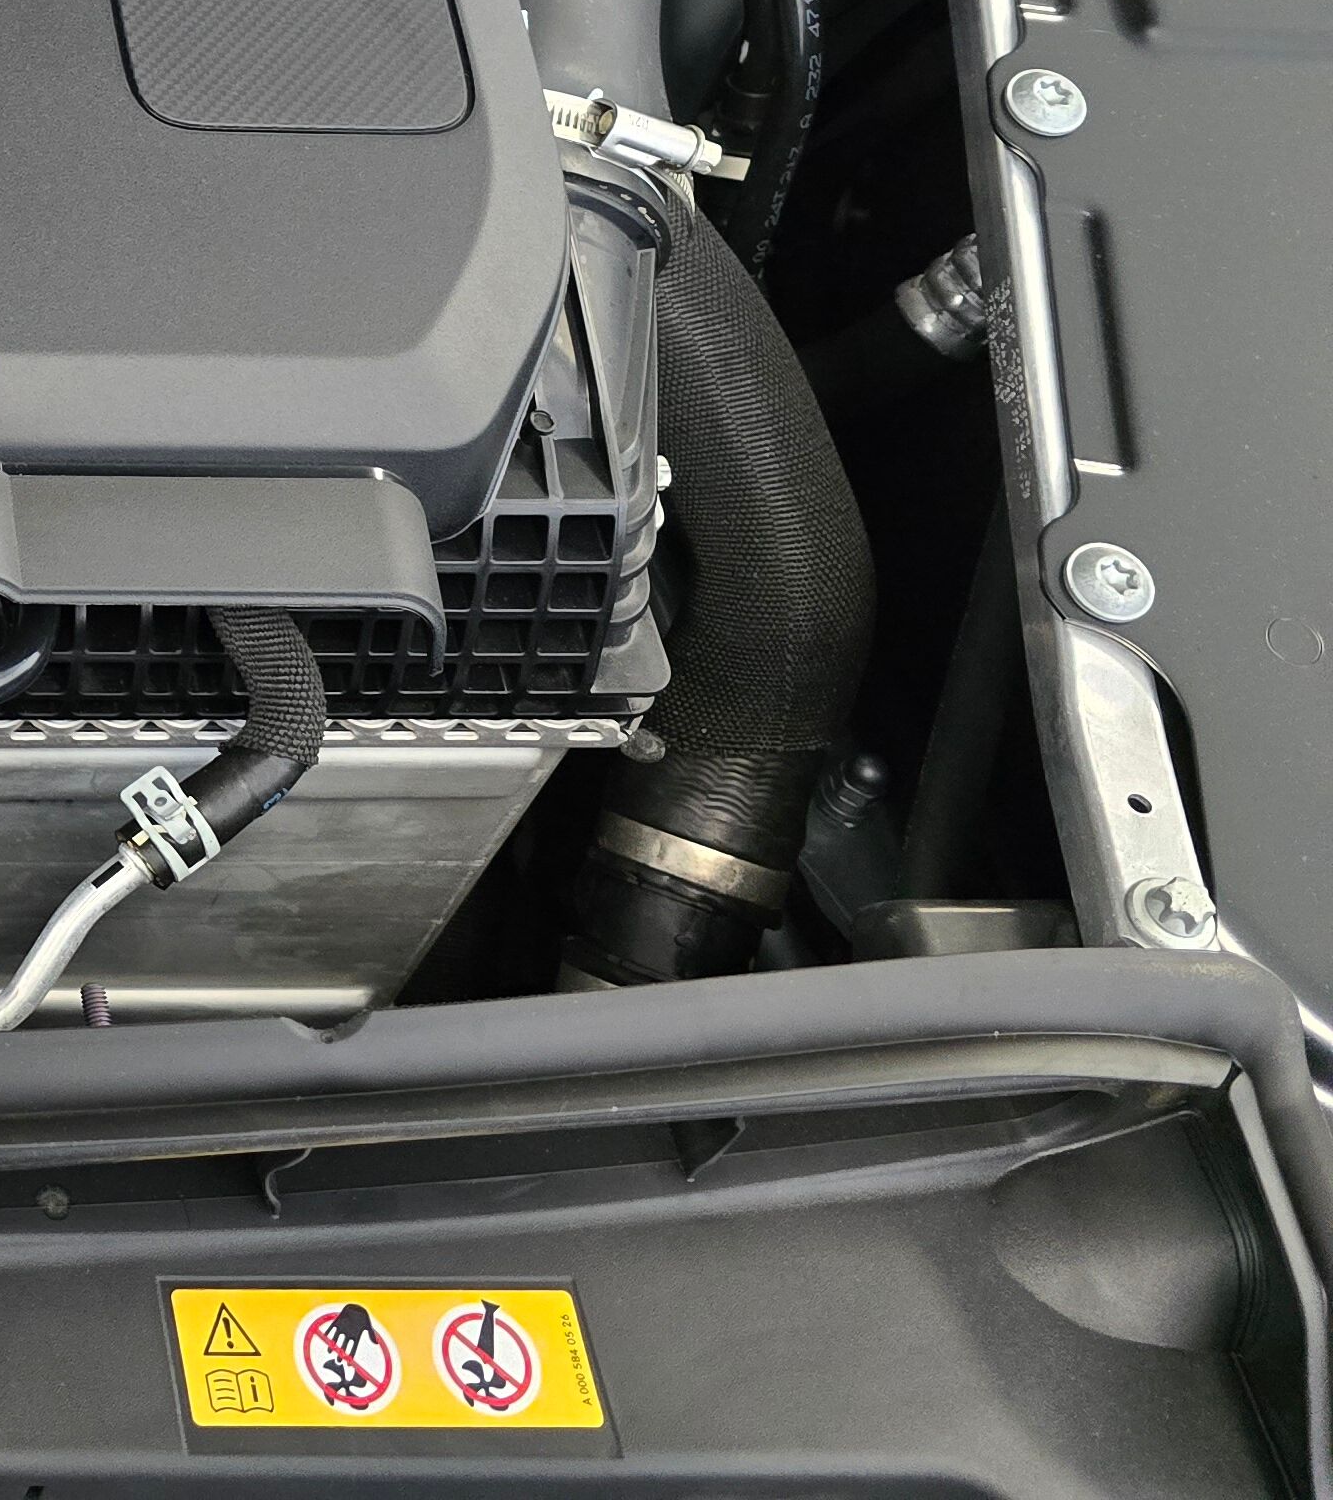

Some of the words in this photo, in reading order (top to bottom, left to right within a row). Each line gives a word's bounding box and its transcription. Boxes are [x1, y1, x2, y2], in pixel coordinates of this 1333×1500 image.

[560, 1314, 572, 1328] 26
[565, 1331, 576, 1345] 05
[569, 1349, 582, 1370] 584
[576, 1373, 589, 1394] 000
[582, 1398, 593, 1406] A
